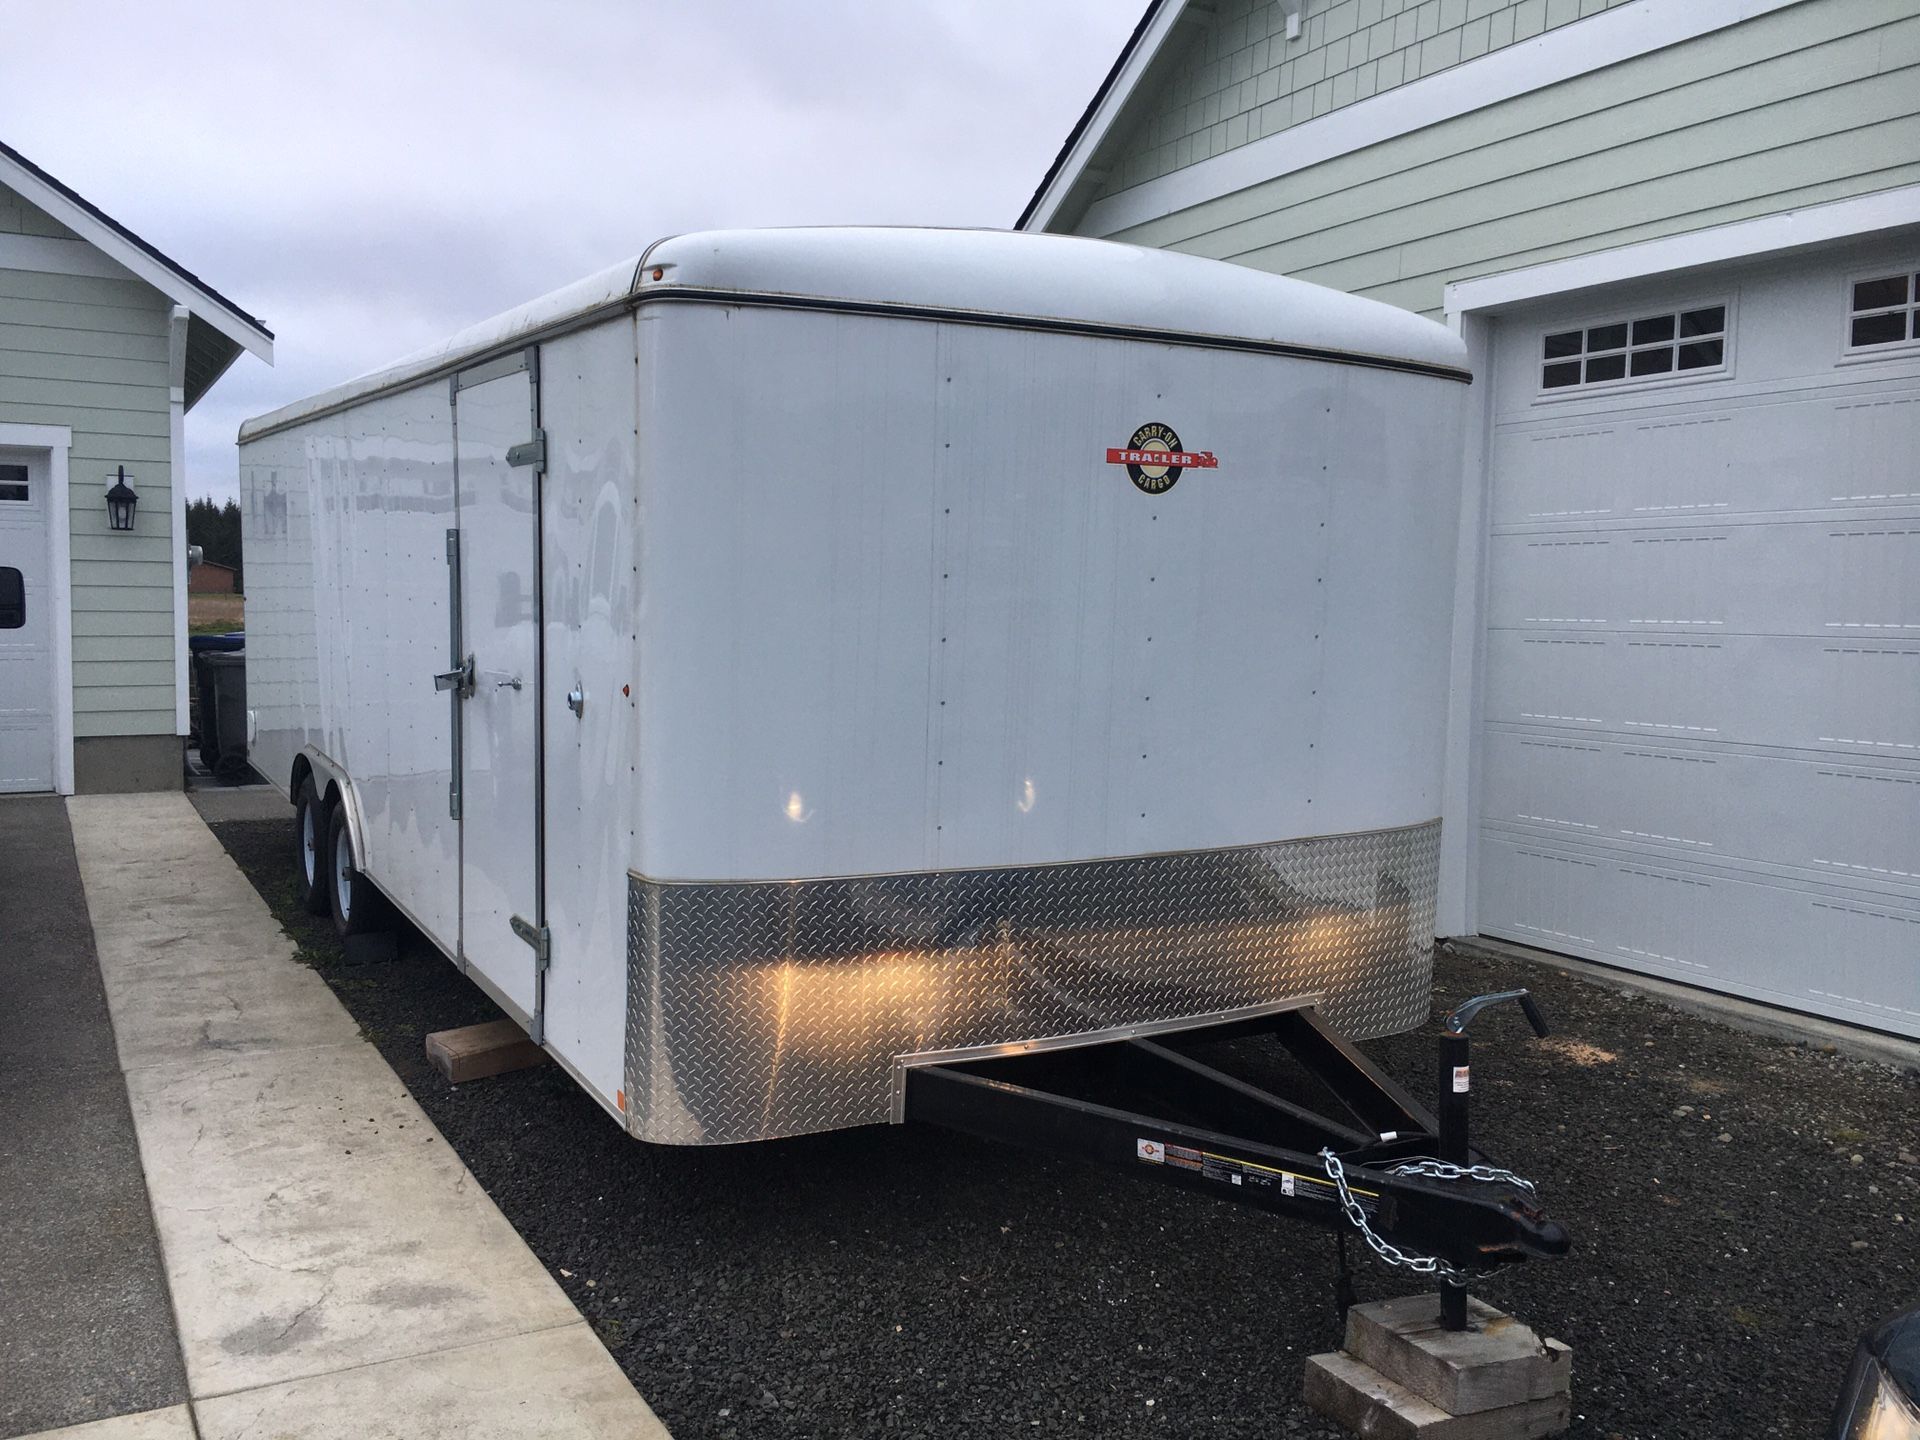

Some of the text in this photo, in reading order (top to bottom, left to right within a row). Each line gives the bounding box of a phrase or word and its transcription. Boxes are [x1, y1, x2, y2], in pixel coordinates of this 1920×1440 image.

[1133, 425, 1178, 448] CARRY-ON
[1119, 452, 1192, 464] TRAILER
[1138, 475, 1171, 489] CARGO
